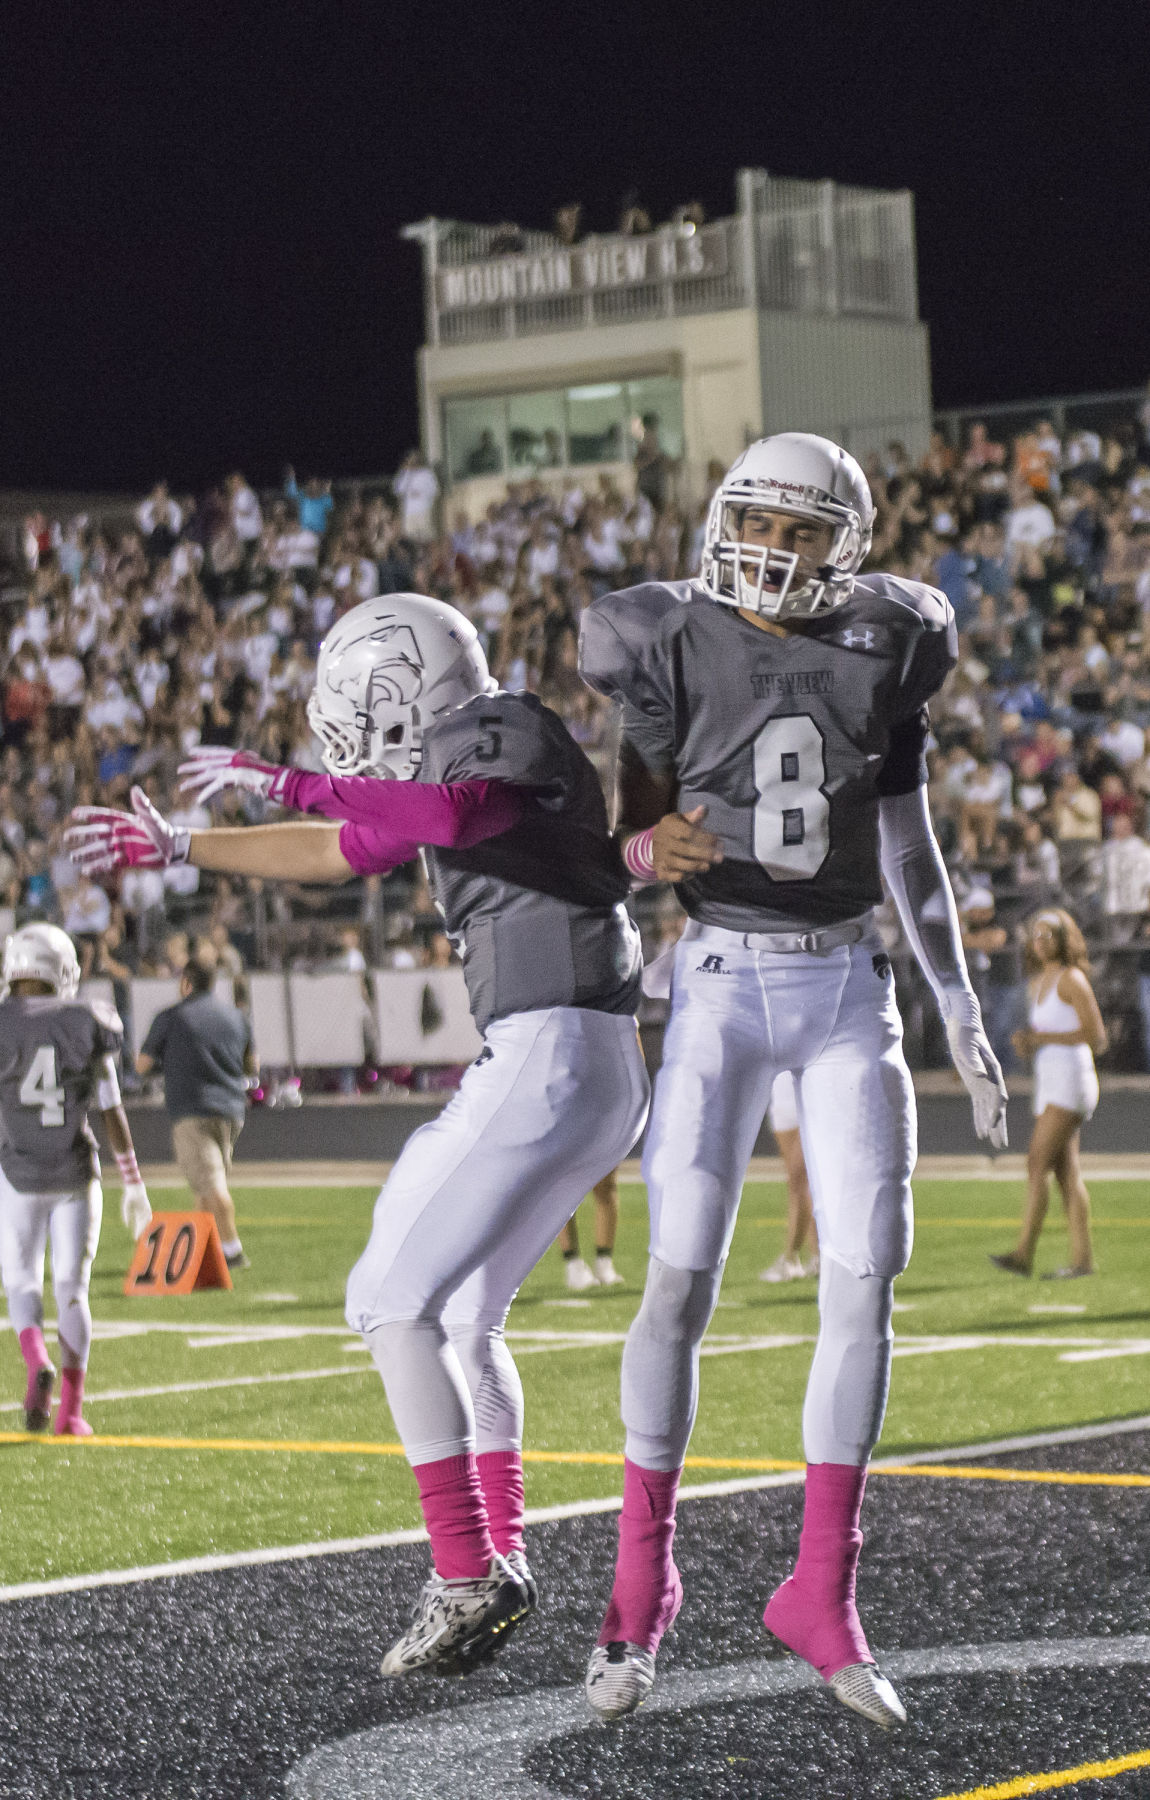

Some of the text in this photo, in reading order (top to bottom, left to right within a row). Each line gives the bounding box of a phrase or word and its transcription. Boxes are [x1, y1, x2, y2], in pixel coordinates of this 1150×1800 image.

[445, 251, 572, 305] MOUNTAIN
[583, 242, 648, 288] VIEW
[768, 478, 805, 495] Riddell
[785, 671, 834, 695] VIEW
[475, 716, 503, 763] 5
[752, 713, 832, 883] 8
[695, 966, 732, 975] RUSSELL
[20, 1046, 65, 1126] 4
[134, 1223, 197, 1285] 10
